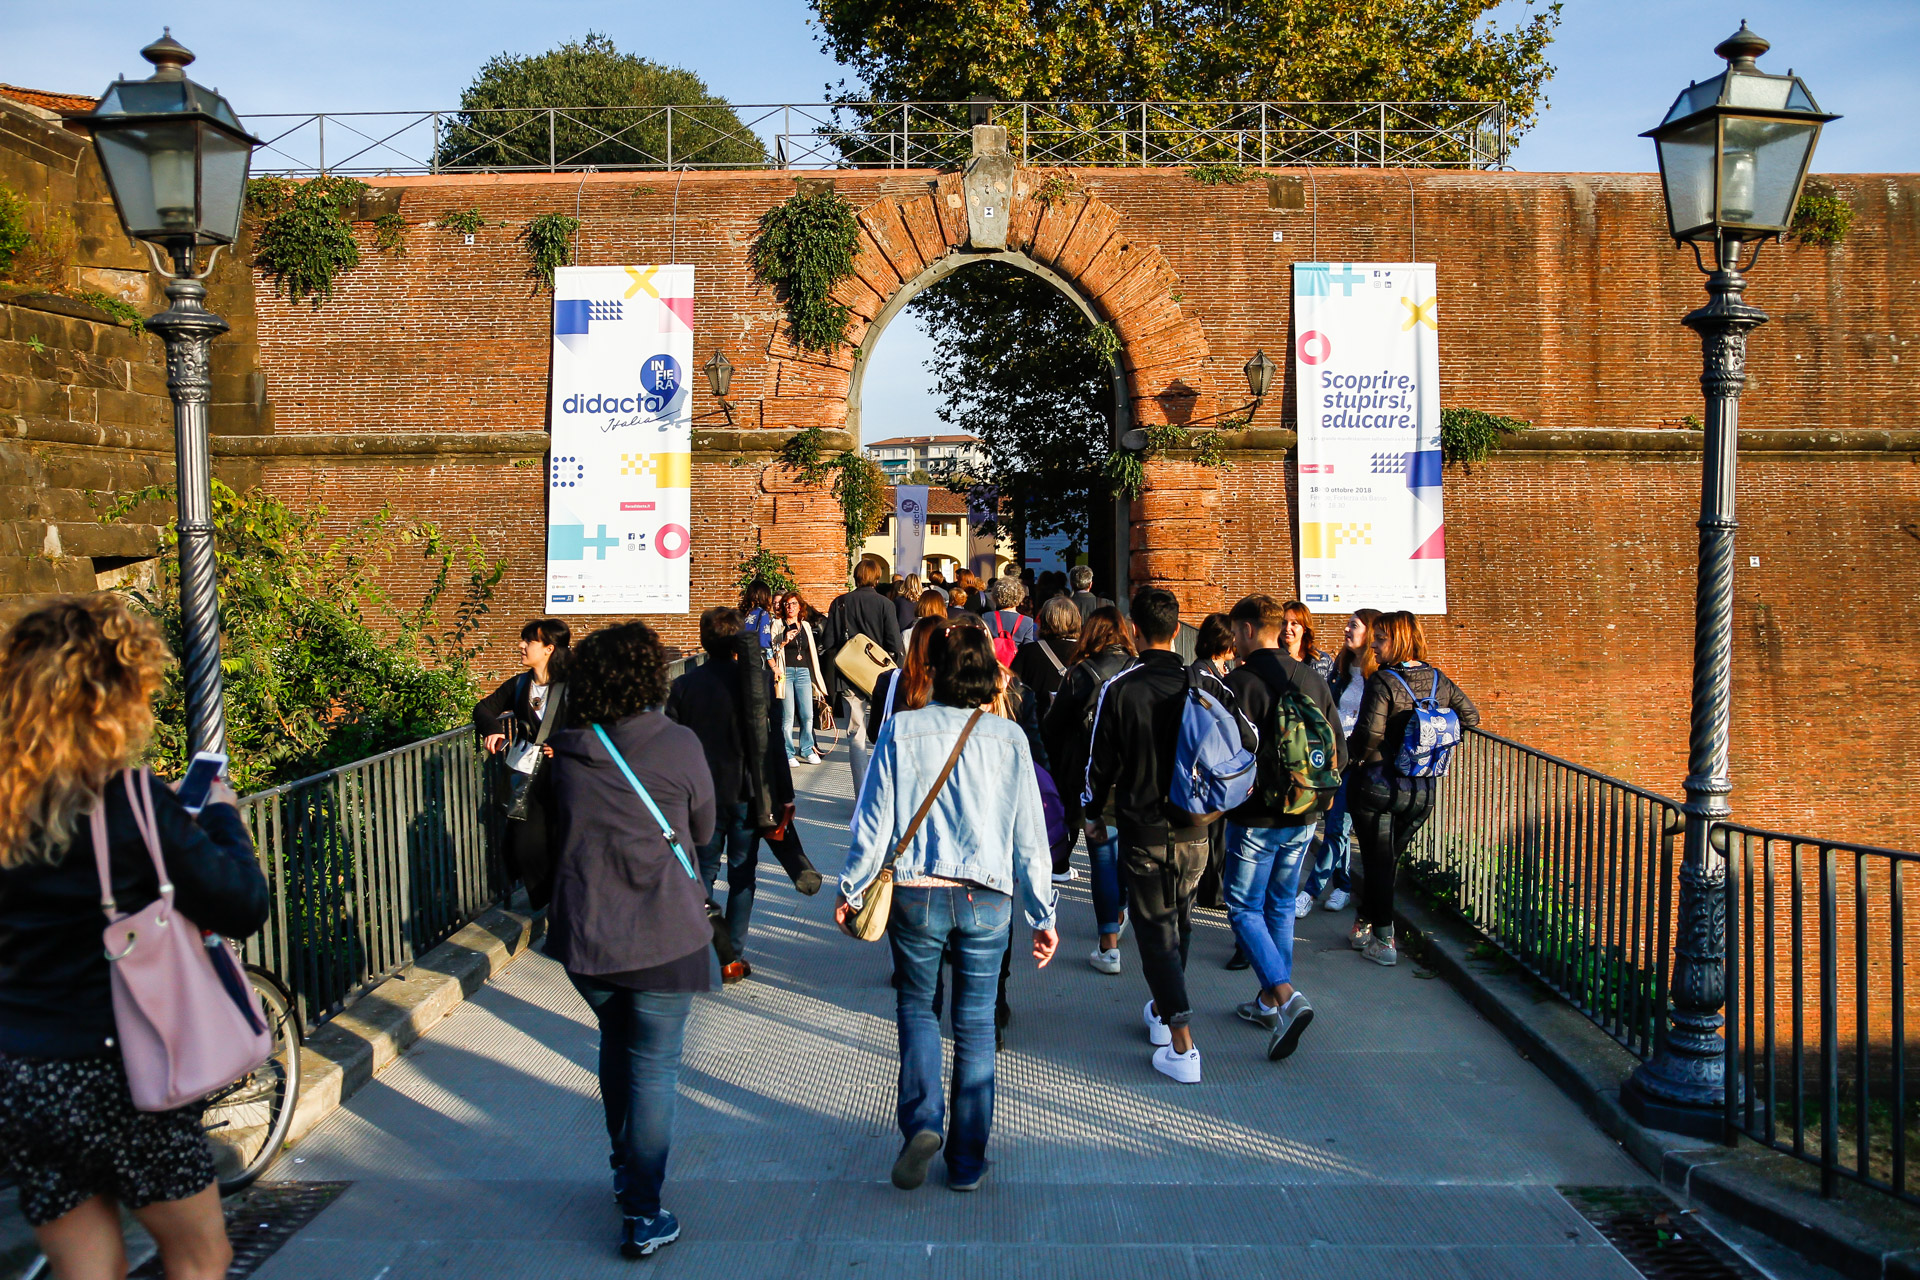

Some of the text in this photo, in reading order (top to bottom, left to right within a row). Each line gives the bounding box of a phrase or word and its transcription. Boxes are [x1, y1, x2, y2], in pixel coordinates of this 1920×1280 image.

[651, 360, 664, 371] IN
[656, 369, 674, 381] FIE
[656, 380, 674, 391] RA
[1320, 370, 1416, 393] Scoprire,
[562, 393, 660, 414] didacta
[1323, 390, 1412, 413] stupirsi,
[1321, 410, 1416, 429] educare.
